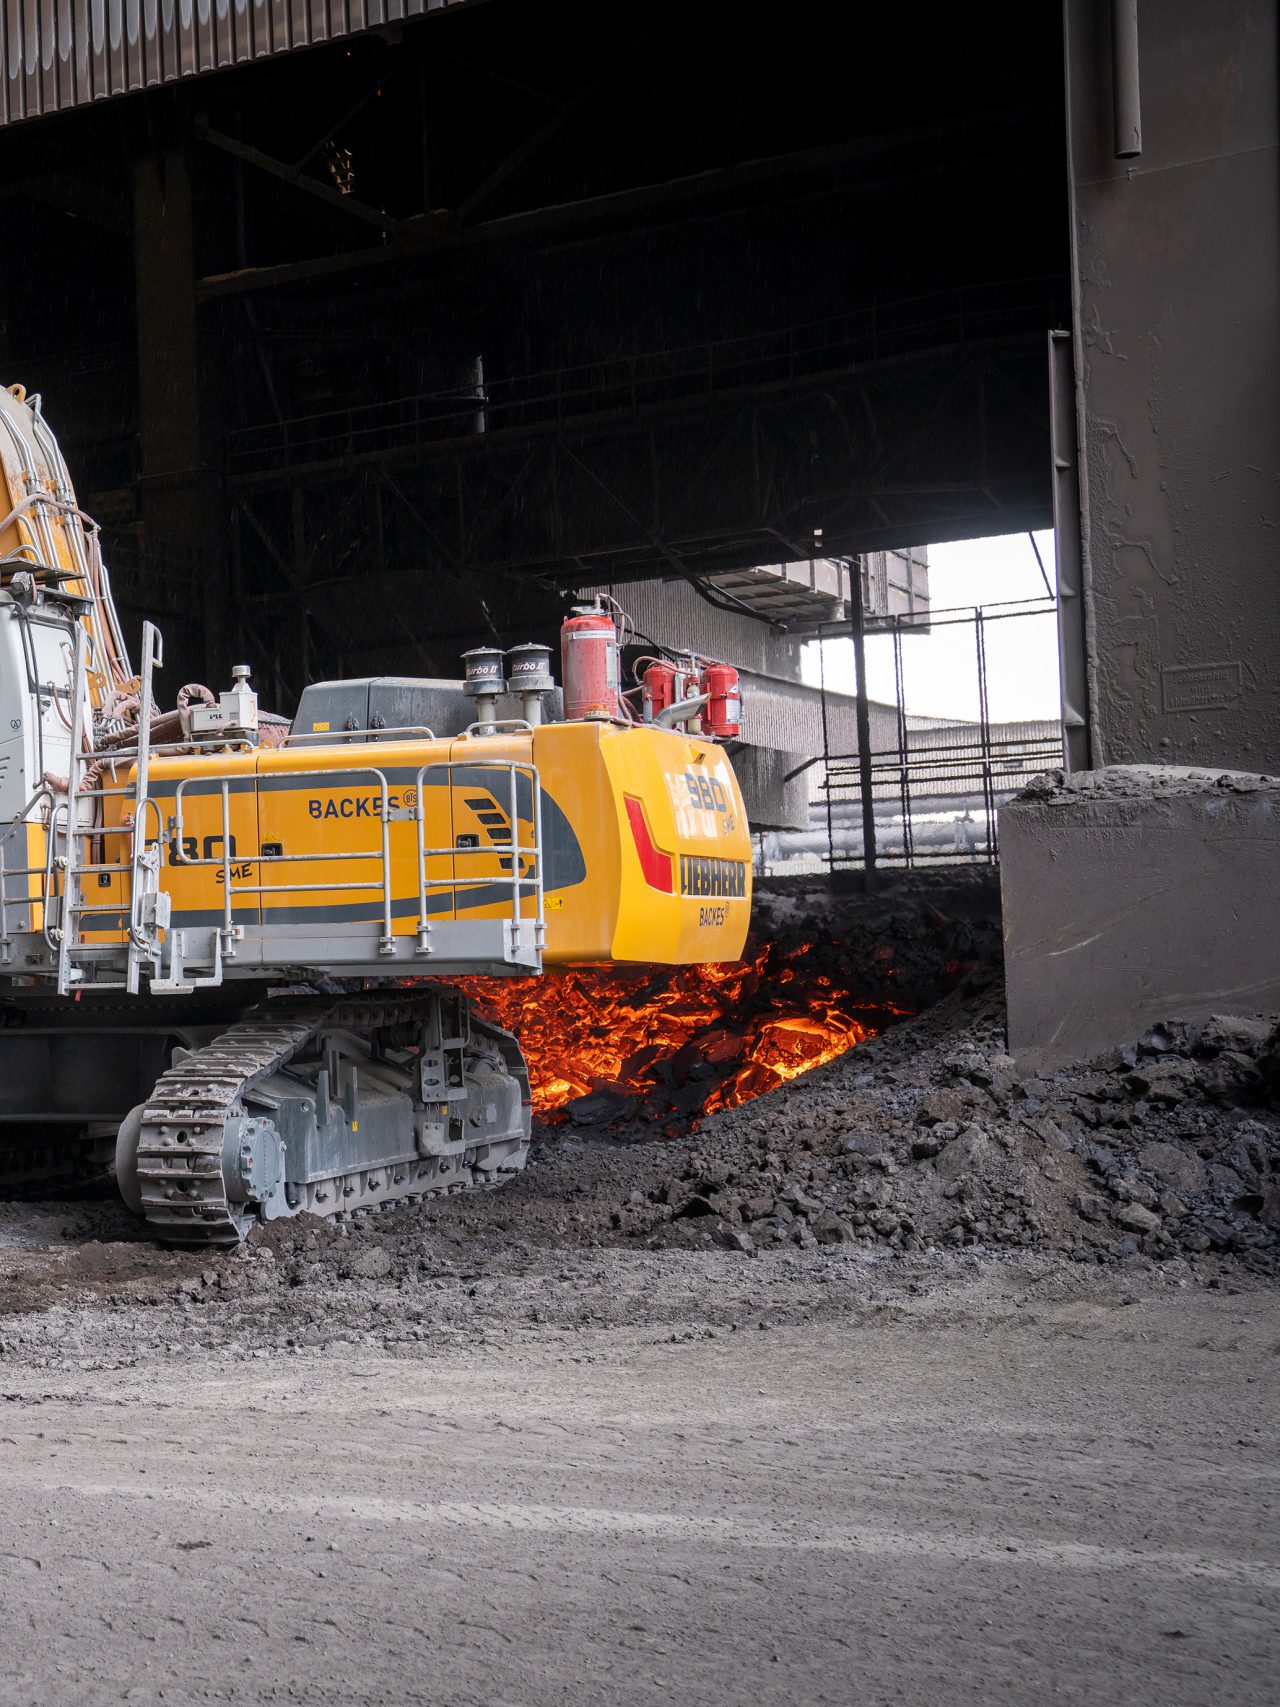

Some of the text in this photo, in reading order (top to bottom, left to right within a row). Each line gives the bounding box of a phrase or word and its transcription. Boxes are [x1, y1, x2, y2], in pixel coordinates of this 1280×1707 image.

[684, 773, 727, 813] 980
[144, 835, 237, 867] 80
[215, 862, 253, 884] SME
[680, 857, 746, 897] LIEBHERR
[699, 907, 725, 927] BACKES
